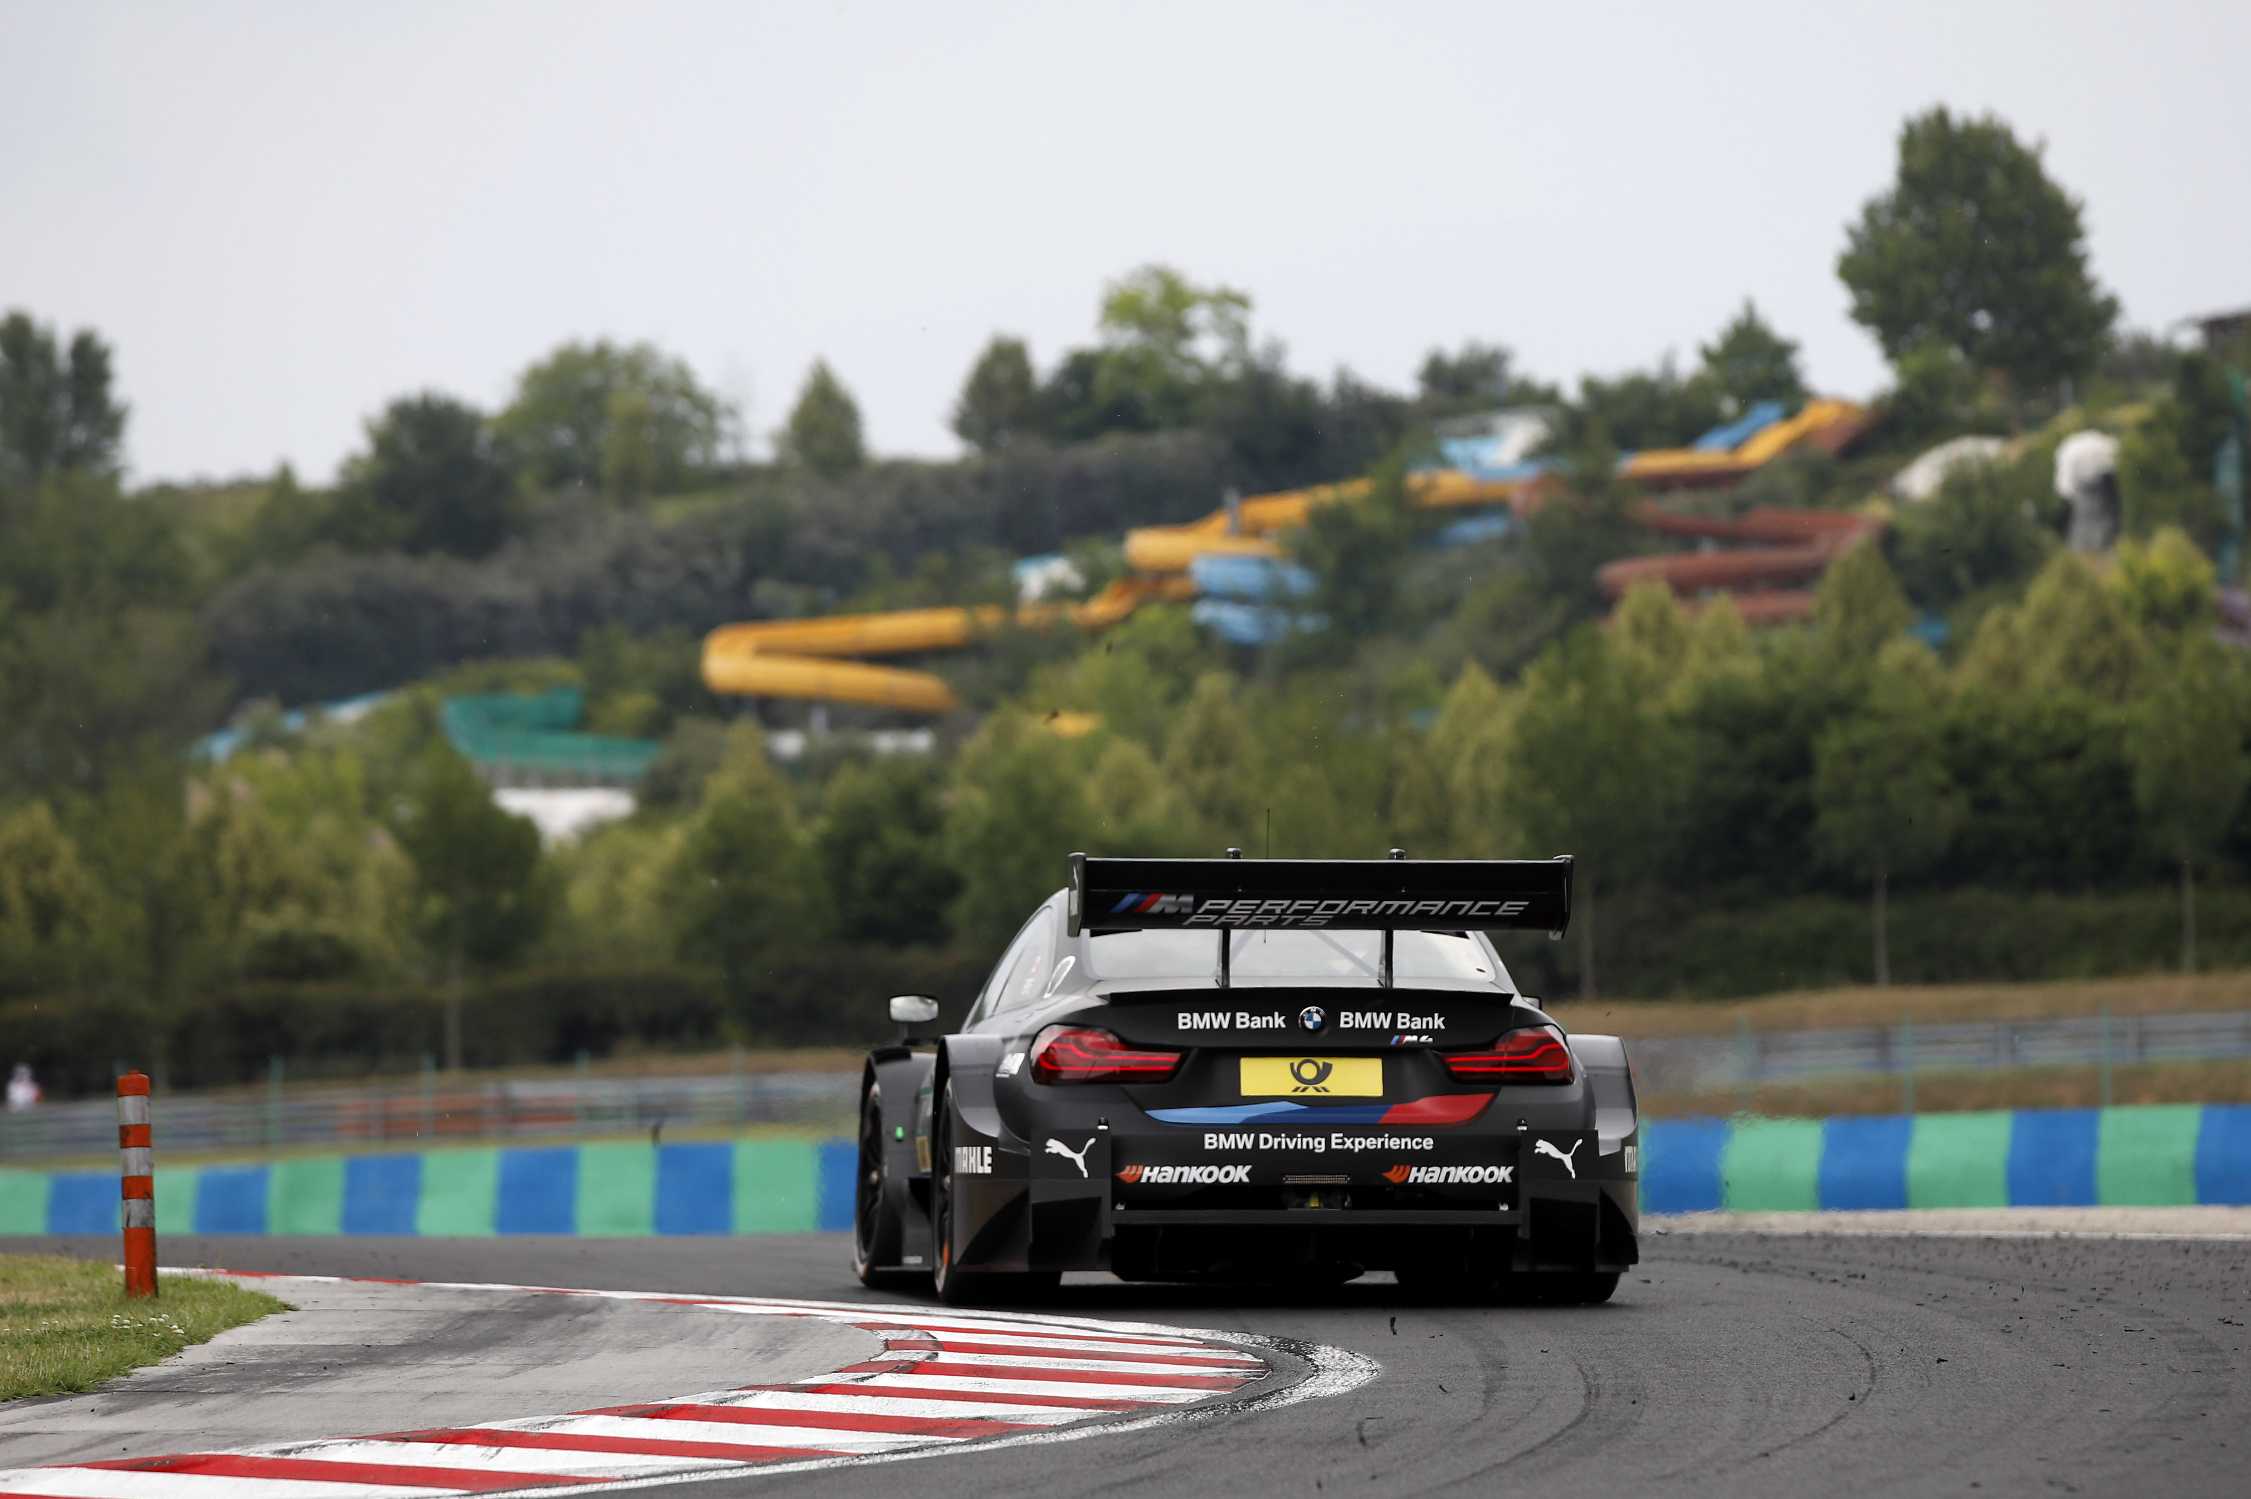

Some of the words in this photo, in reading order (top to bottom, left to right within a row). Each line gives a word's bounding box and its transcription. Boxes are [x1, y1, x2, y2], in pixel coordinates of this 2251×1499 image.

[1196, 899, 1530, 916] PERFORMANCE
[1182, 914, 1335, 927] PARTS
[1177, 1012, 1231, 1030] BMW
[1235, 1011, 1287, 1029] Bank
[1339, 1011, 1392, 1029] BMW
[1396, 1012, 1446, 1030] Bank
[1203, 1133, 1254, 1150] BMW
[1258, 1132, 1325, 1153] Driving
[1330, 1132, 1434, 1153] Experience
[954, 1146, 993, 1174] MAHLE
